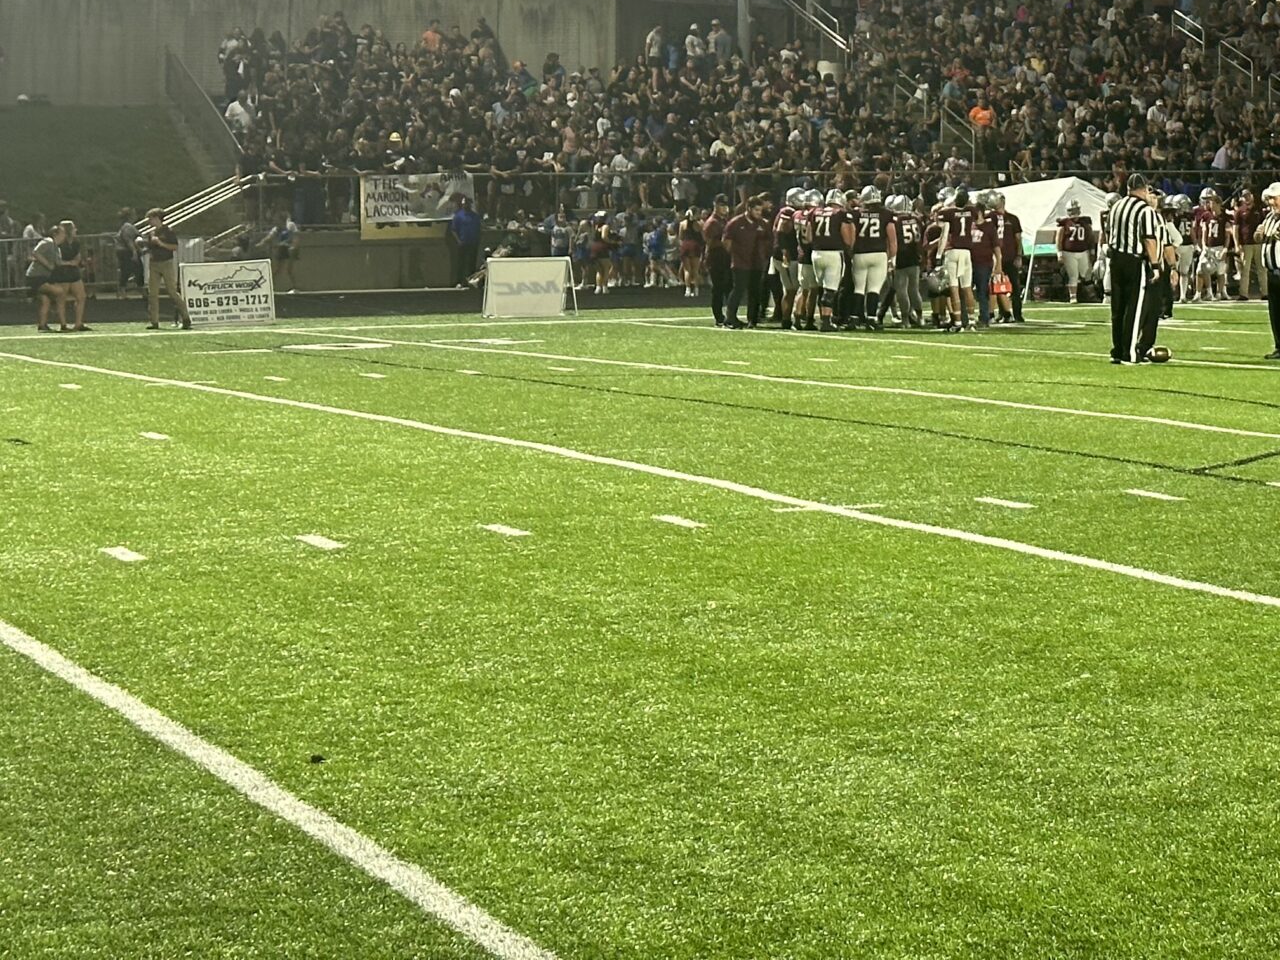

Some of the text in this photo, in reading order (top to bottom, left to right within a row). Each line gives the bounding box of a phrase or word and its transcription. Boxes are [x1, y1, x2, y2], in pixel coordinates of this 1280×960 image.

[371, 178, 399, 190] THE
[366, 191, 409, 203] MAROON
[365, 204, 409, 218] LAGOON
[815, 216, 830, 236] 71
[859, 218, 880, 237] 72
[960, 217, 966, 236] 1
[1069, 226, 1085, 241] 70
[207, 282, 234, 290] TRUCK
[188, 295, 269, 308] 606-679-1717
